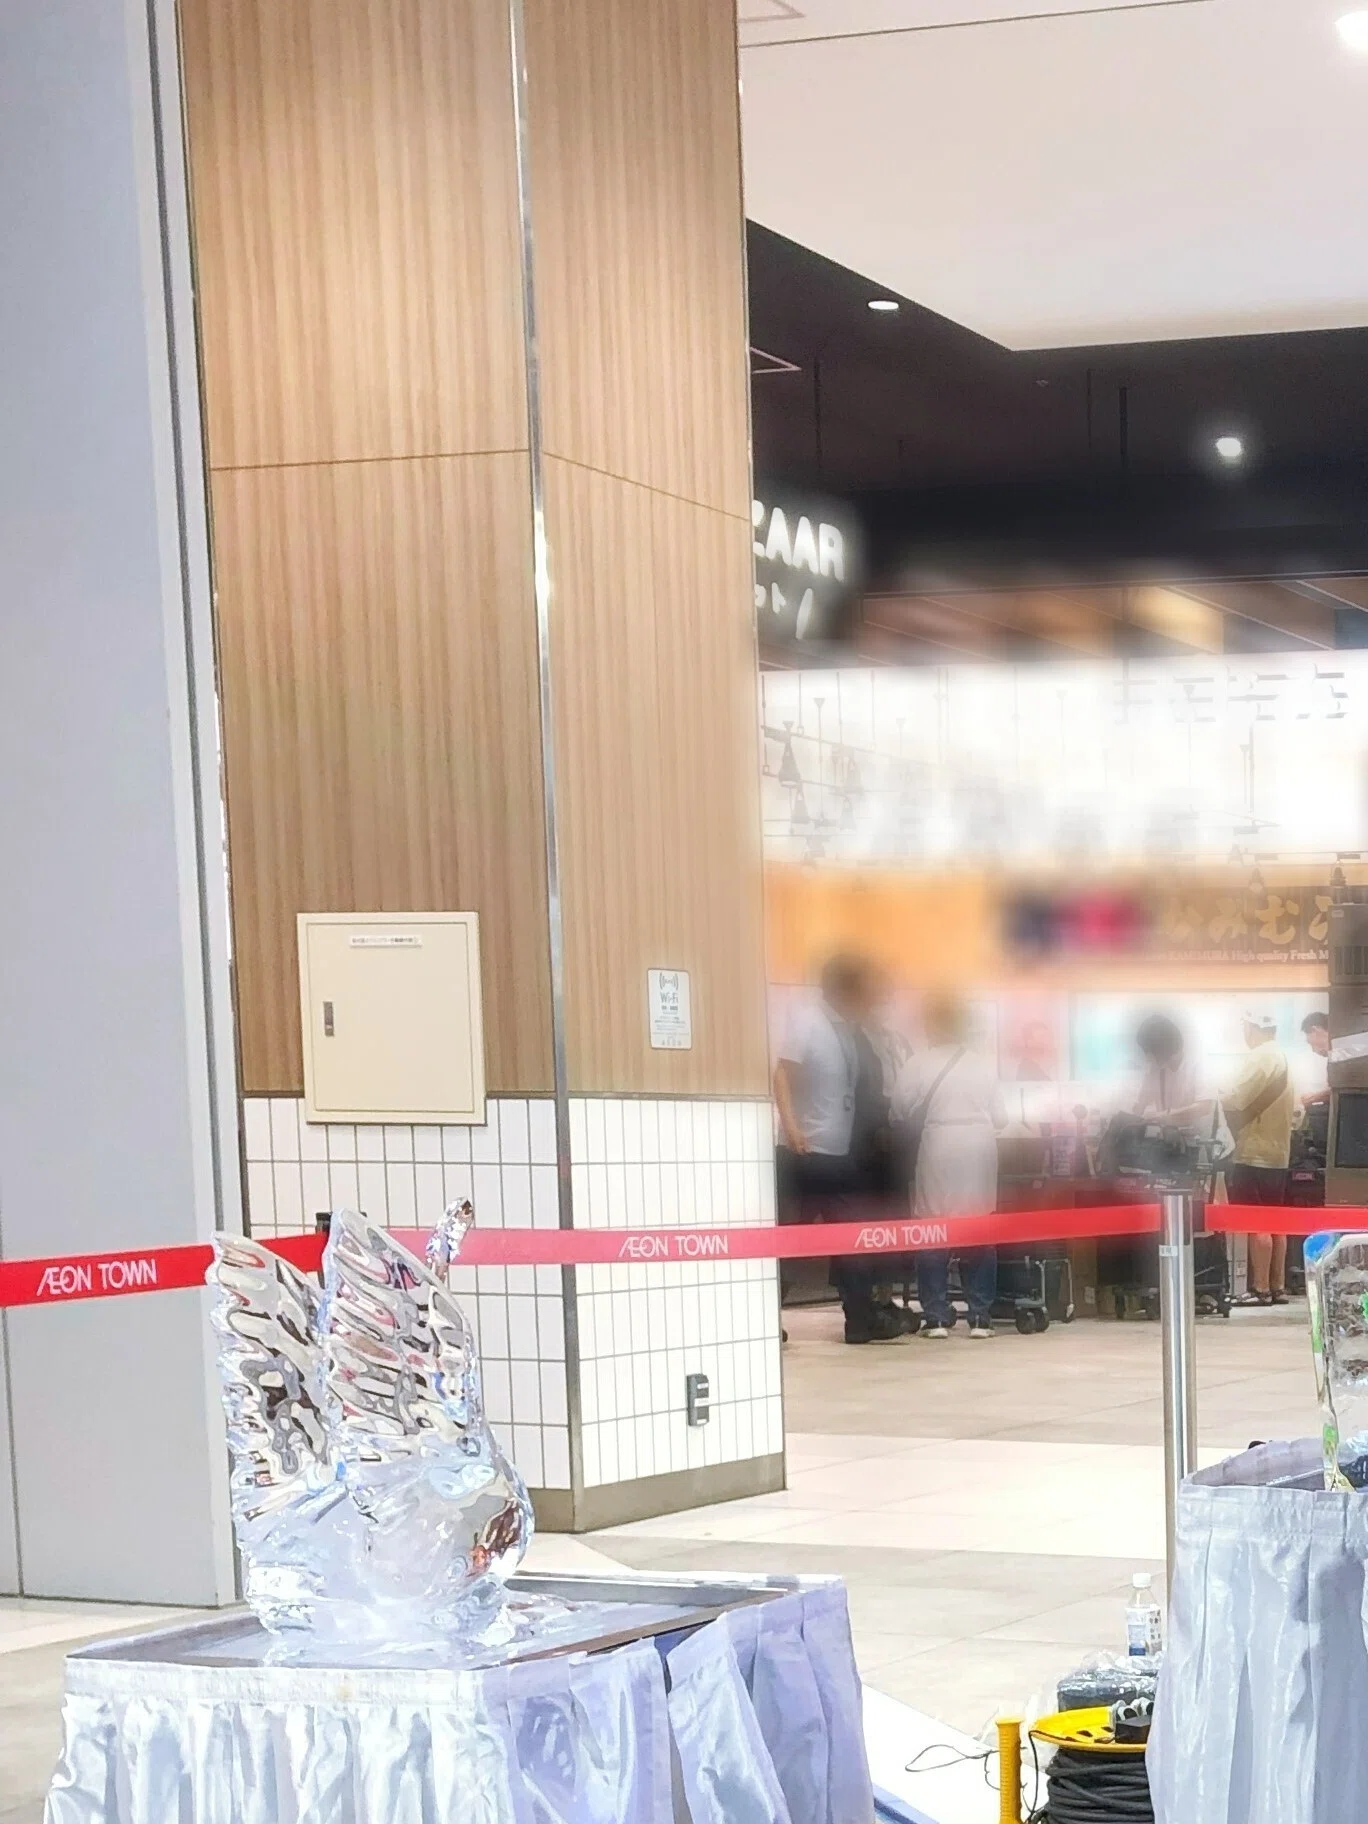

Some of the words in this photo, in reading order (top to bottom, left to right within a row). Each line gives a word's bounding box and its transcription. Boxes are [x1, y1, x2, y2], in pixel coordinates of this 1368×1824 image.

[901, 1224, 948, 1245] TOWN
[675, 1235, 729, 1256] TOWN
[97, 1259, 158, 1290] TOWN
